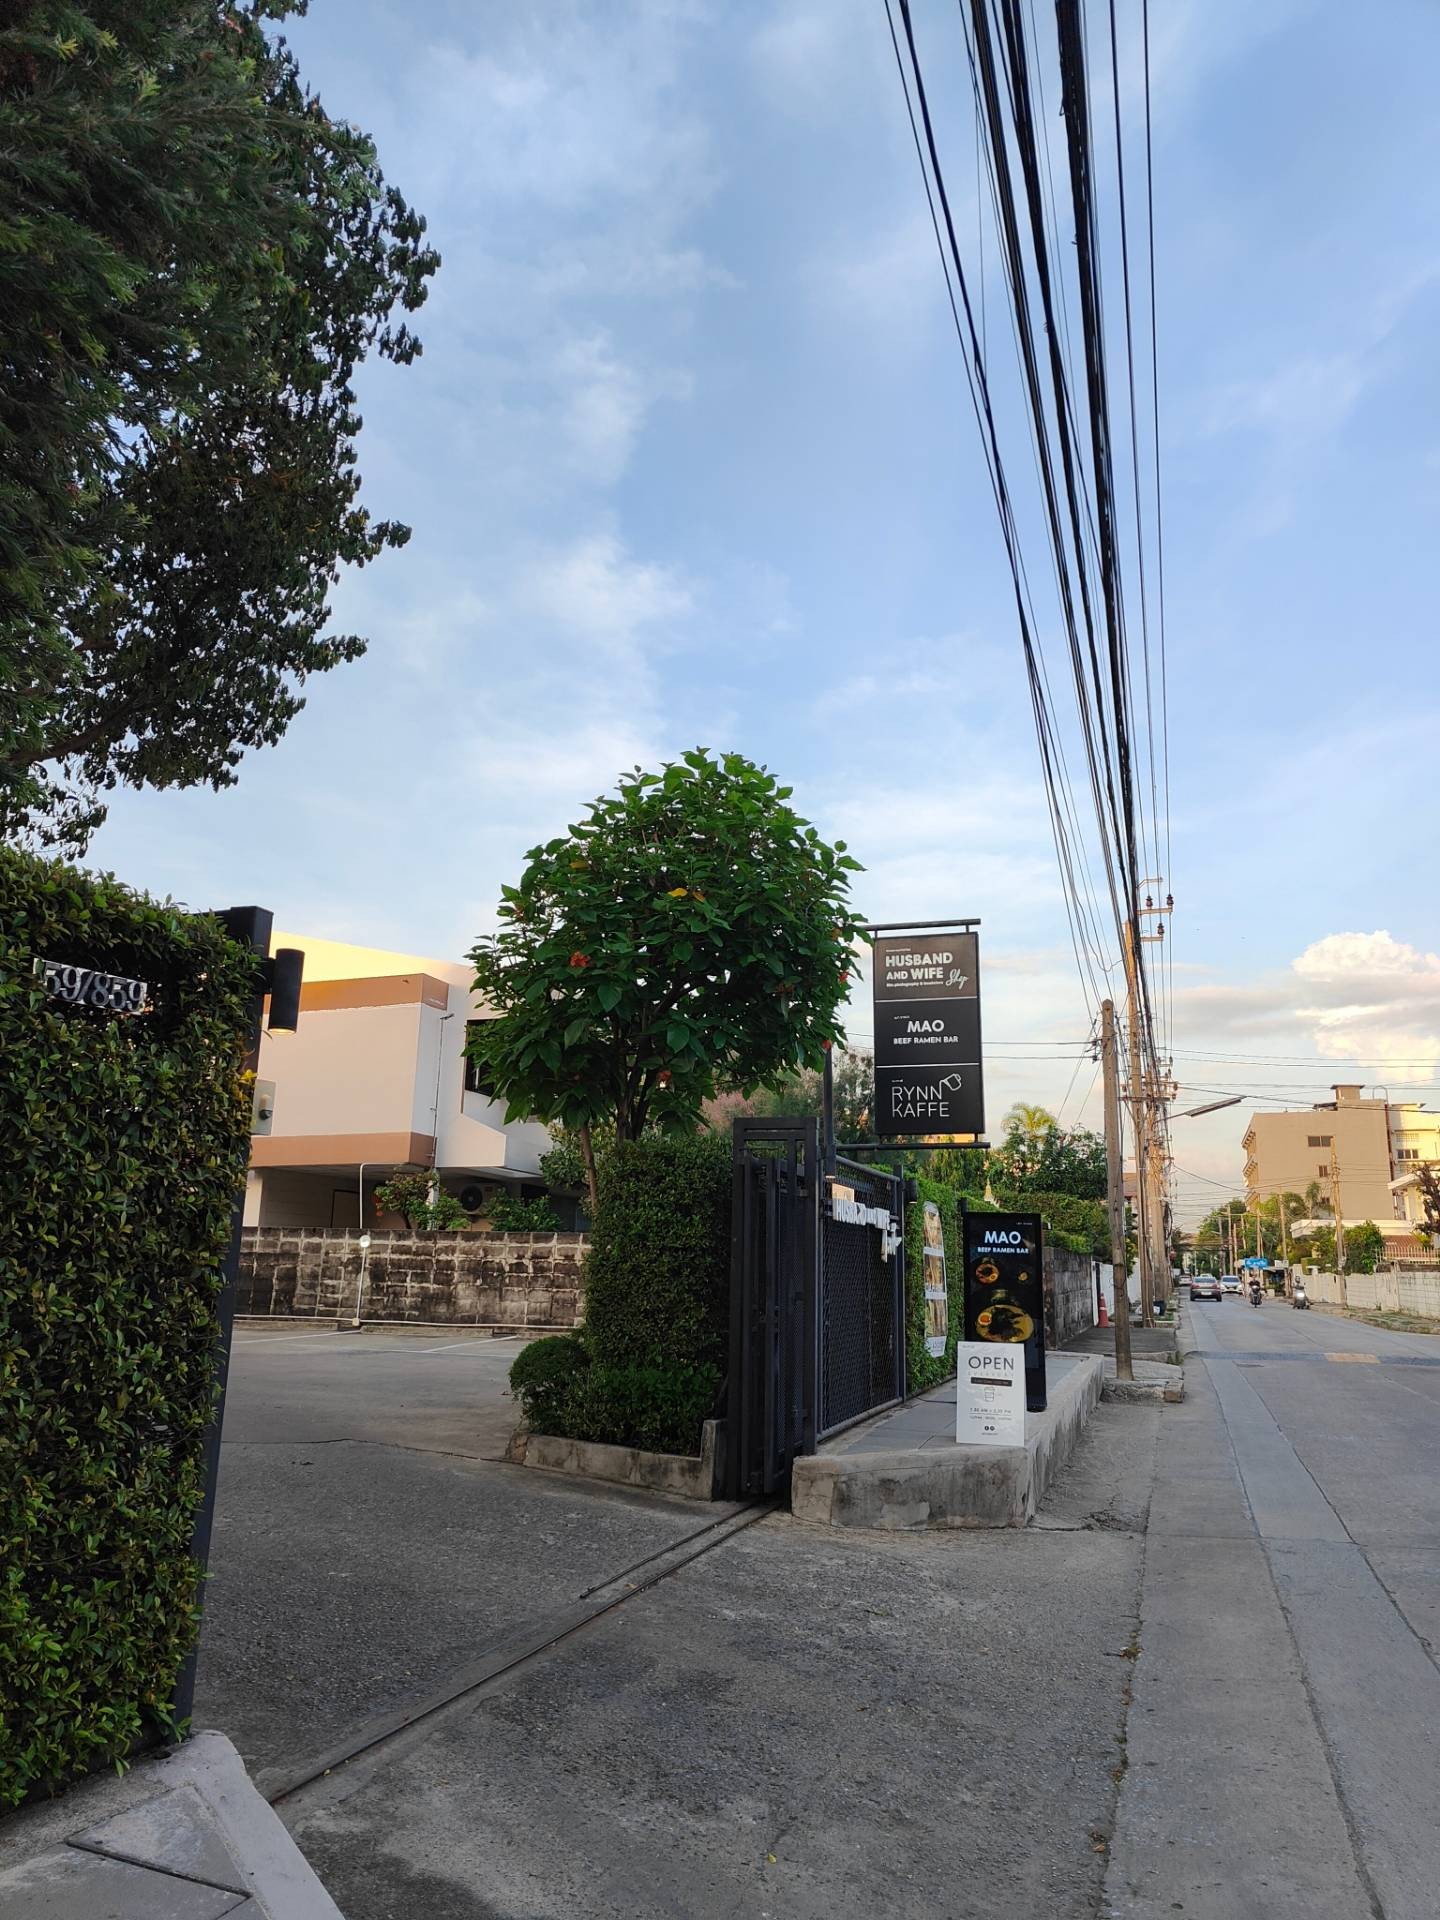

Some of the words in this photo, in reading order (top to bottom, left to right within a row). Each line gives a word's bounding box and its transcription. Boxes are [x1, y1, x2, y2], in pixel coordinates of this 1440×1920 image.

[885, 952, 953, 967] HUSBAND
[886, 971, 908, 980] AND
[910, 967, 944, 980] WIFE
[945, 968, 969, 990] Shop
[907, 1019, 945, 1033] MAO
[893, 1037, 912, 1045] BEEF
[913, 1036, 942, 1044] RAMEN
[943, 1035, 959, 1043] BAR
[891, 1085, 943, 1101] RYNN
[892, 1101, 950, 1118] KAFFE
[984, 1230, 1021, 1245] MAO
[968, 1355, 1015, 1371] OPEN
